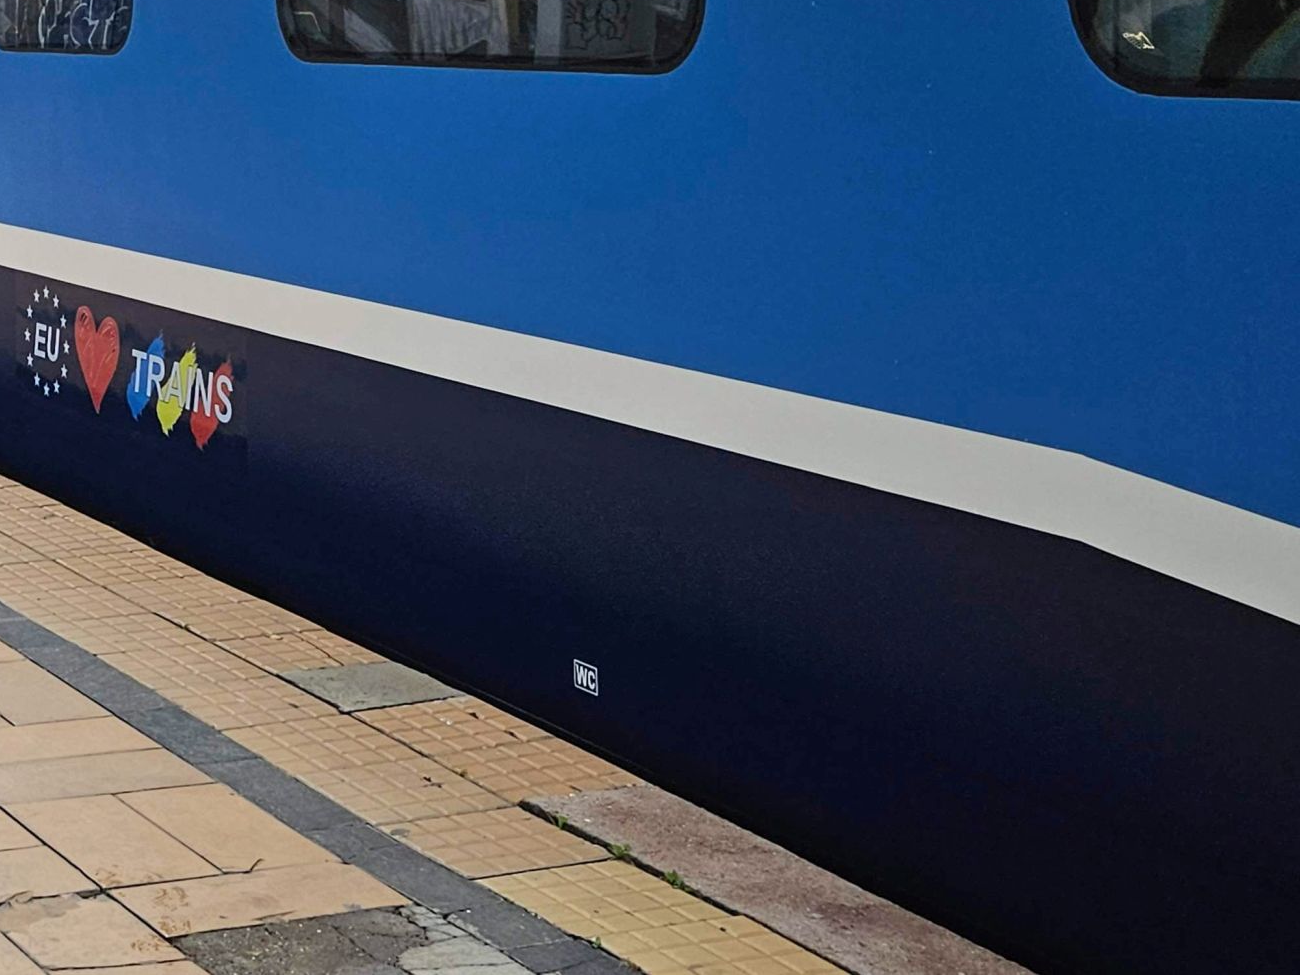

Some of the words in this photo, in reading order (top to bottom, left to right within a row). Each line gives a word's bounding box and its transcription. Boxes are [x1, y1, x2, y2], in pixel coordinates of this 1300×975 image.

[33, 322, 60, 362] EU
[131, 348, 233, 423] TRAINS
[575, 663, 596, 690] WC
